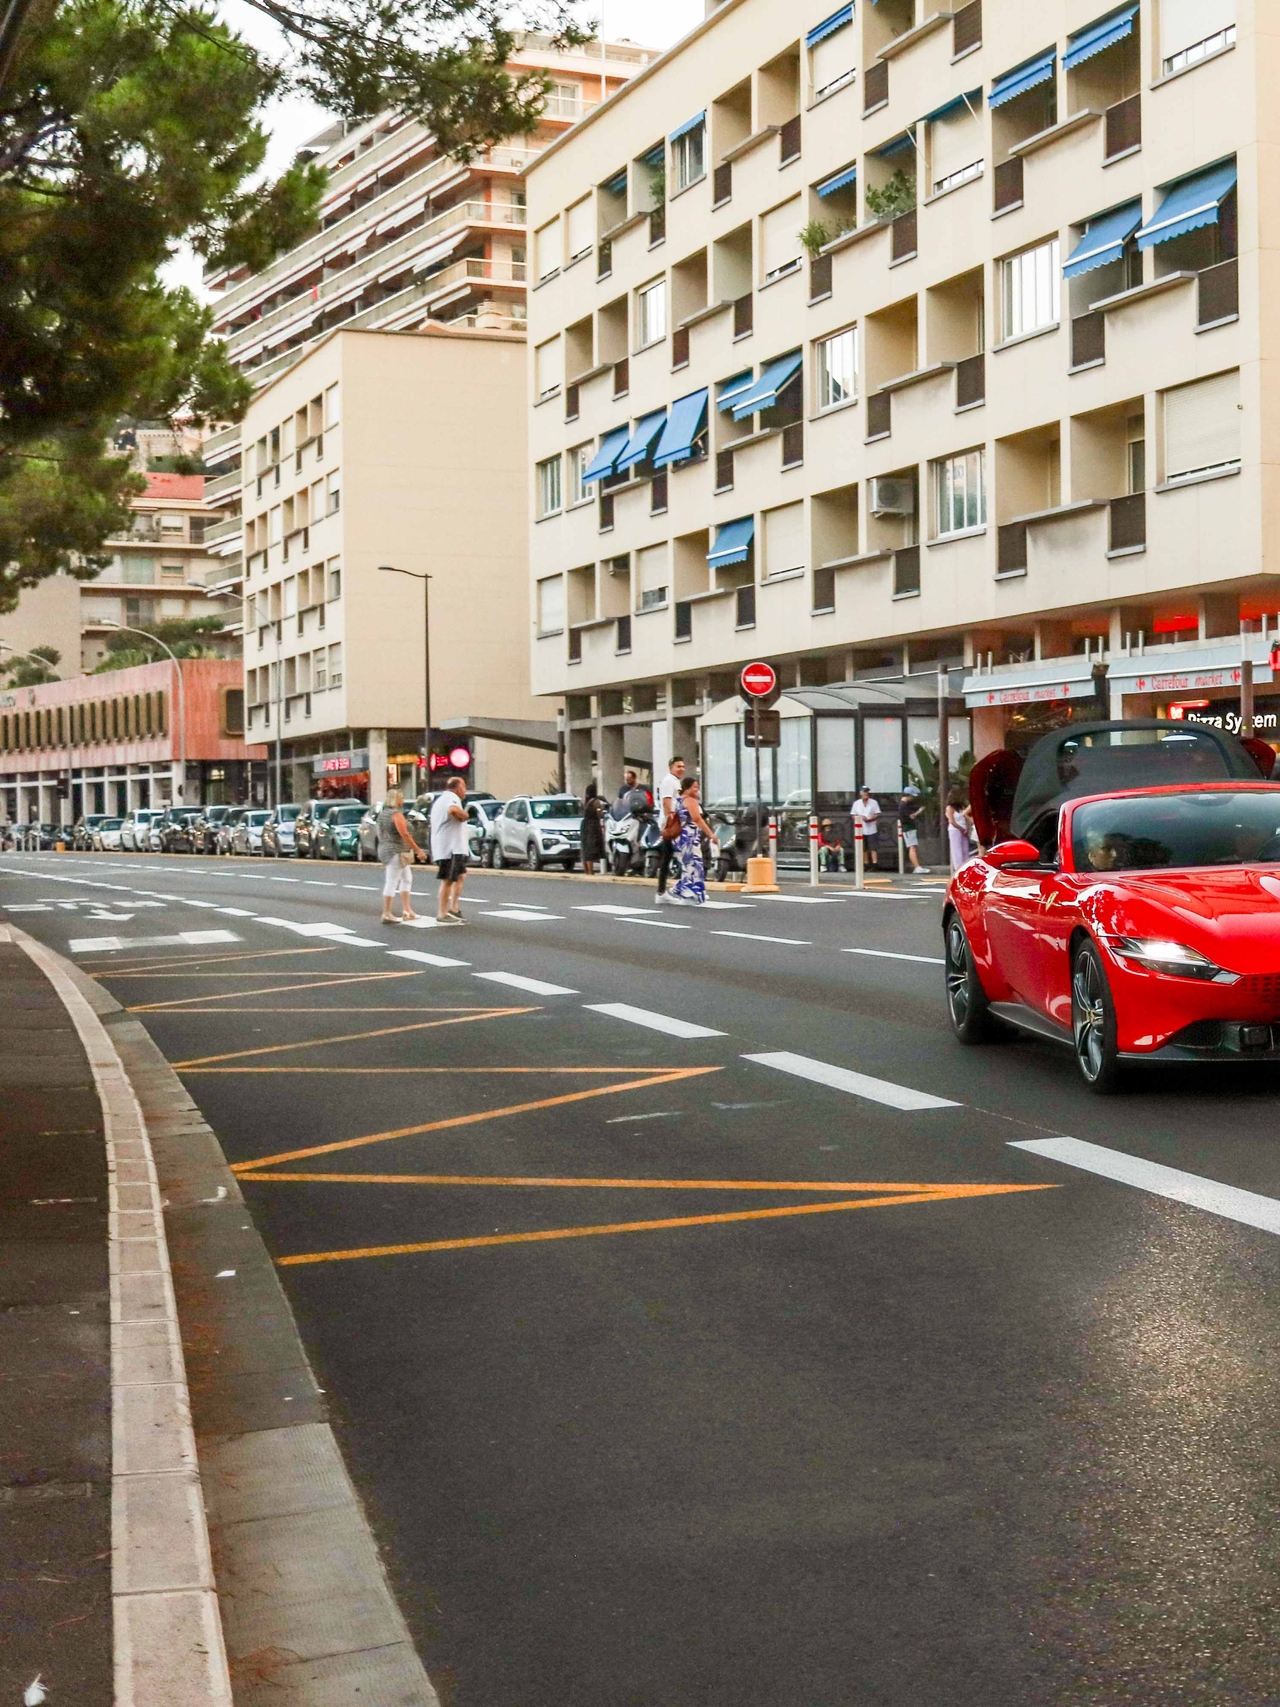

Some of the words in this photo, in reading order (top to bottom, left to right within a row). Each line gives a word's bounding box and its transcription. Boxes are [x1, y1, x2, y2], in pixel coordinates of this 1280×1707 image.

[1151, 674, 1189, 691] Carrefour
[1195, 673, 1223, 687] market
[1000, 687, 1030, 704] Carrefour
[1225, 712, 1277, 735] Syem
